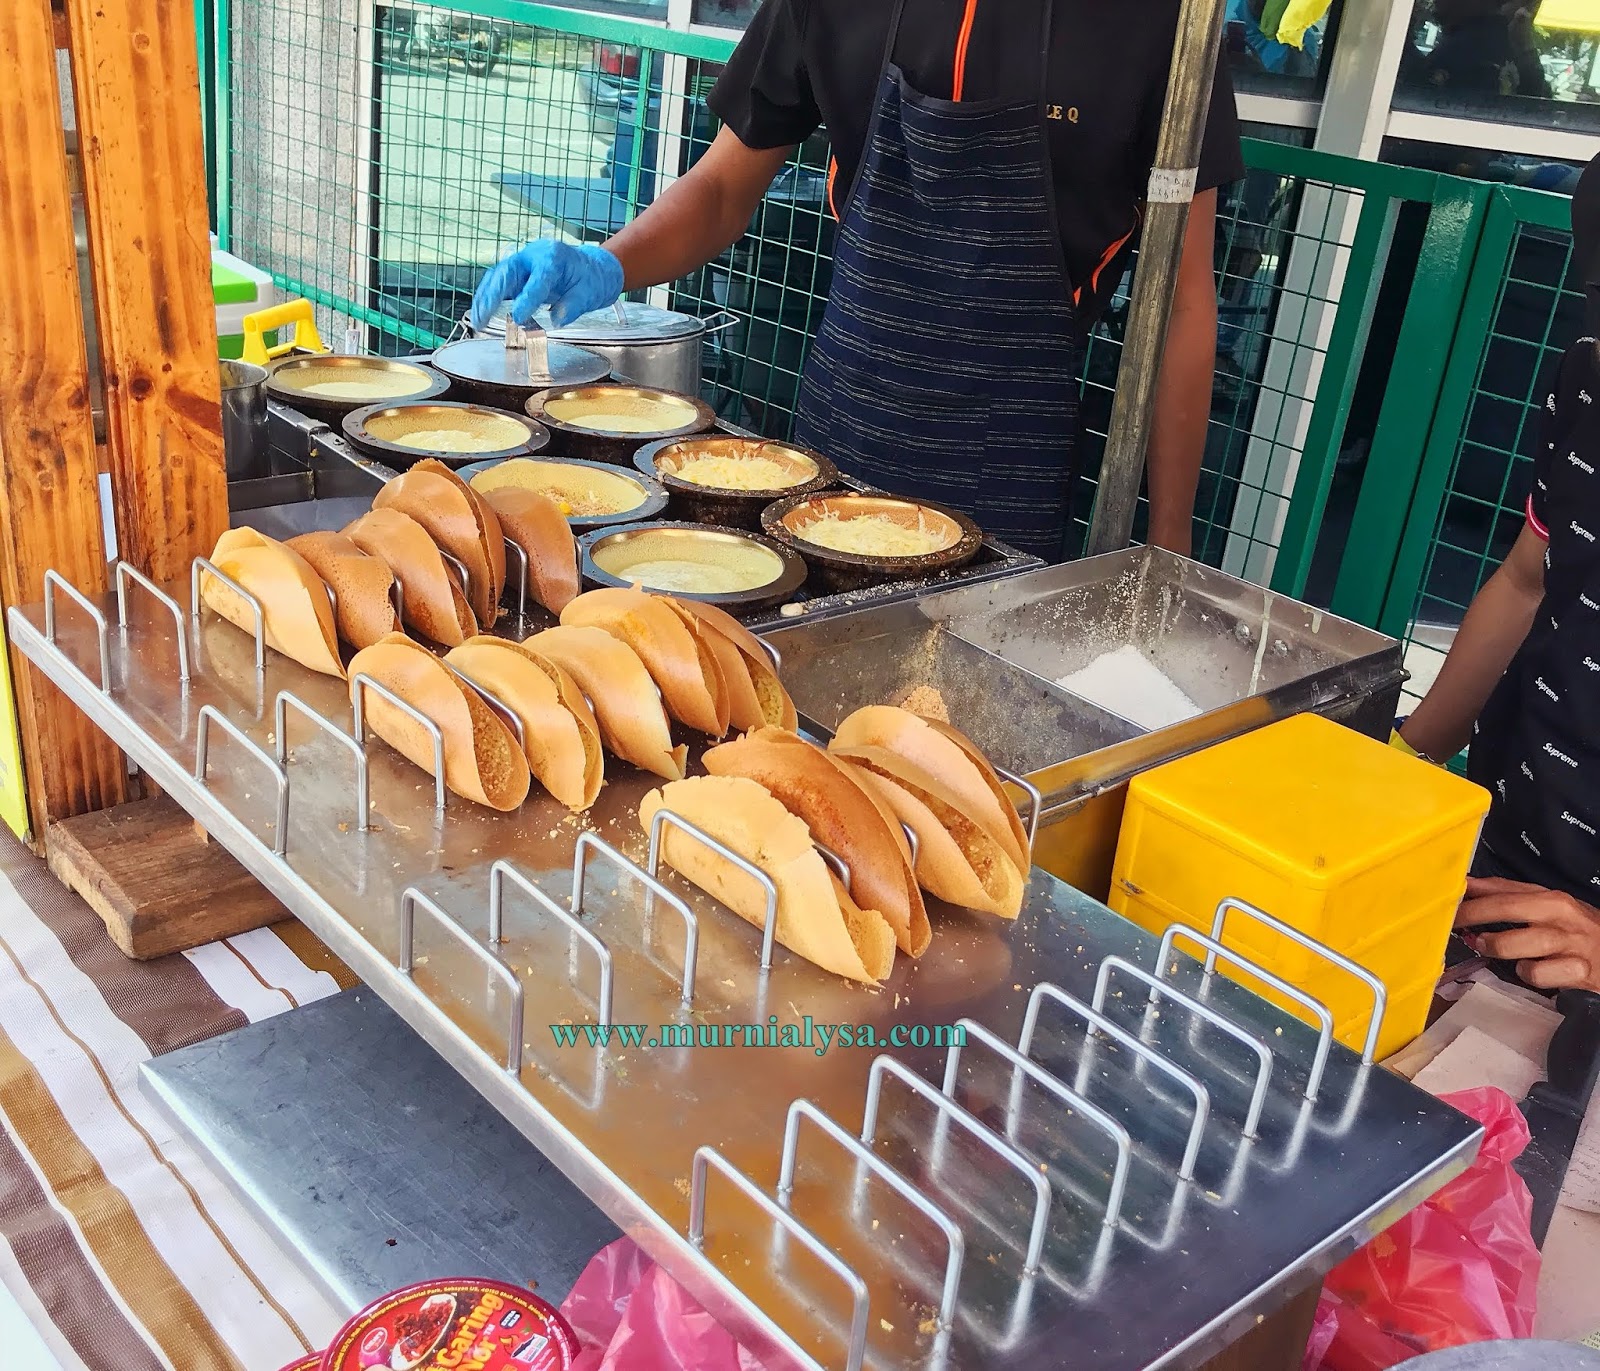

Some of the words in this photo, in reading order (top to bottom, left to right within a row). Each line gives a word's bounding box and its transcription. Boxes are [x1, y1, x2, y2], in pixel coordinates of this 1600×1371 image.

[1567, 451, 1595, 475] Supreme
[1535, 677, 1559, 702] Supreme
[1542, 742, 1580, 768] Supreme
[1560, 810, 1597, 836] Supreme
[1520, 830, 1541, 857] Supreme
